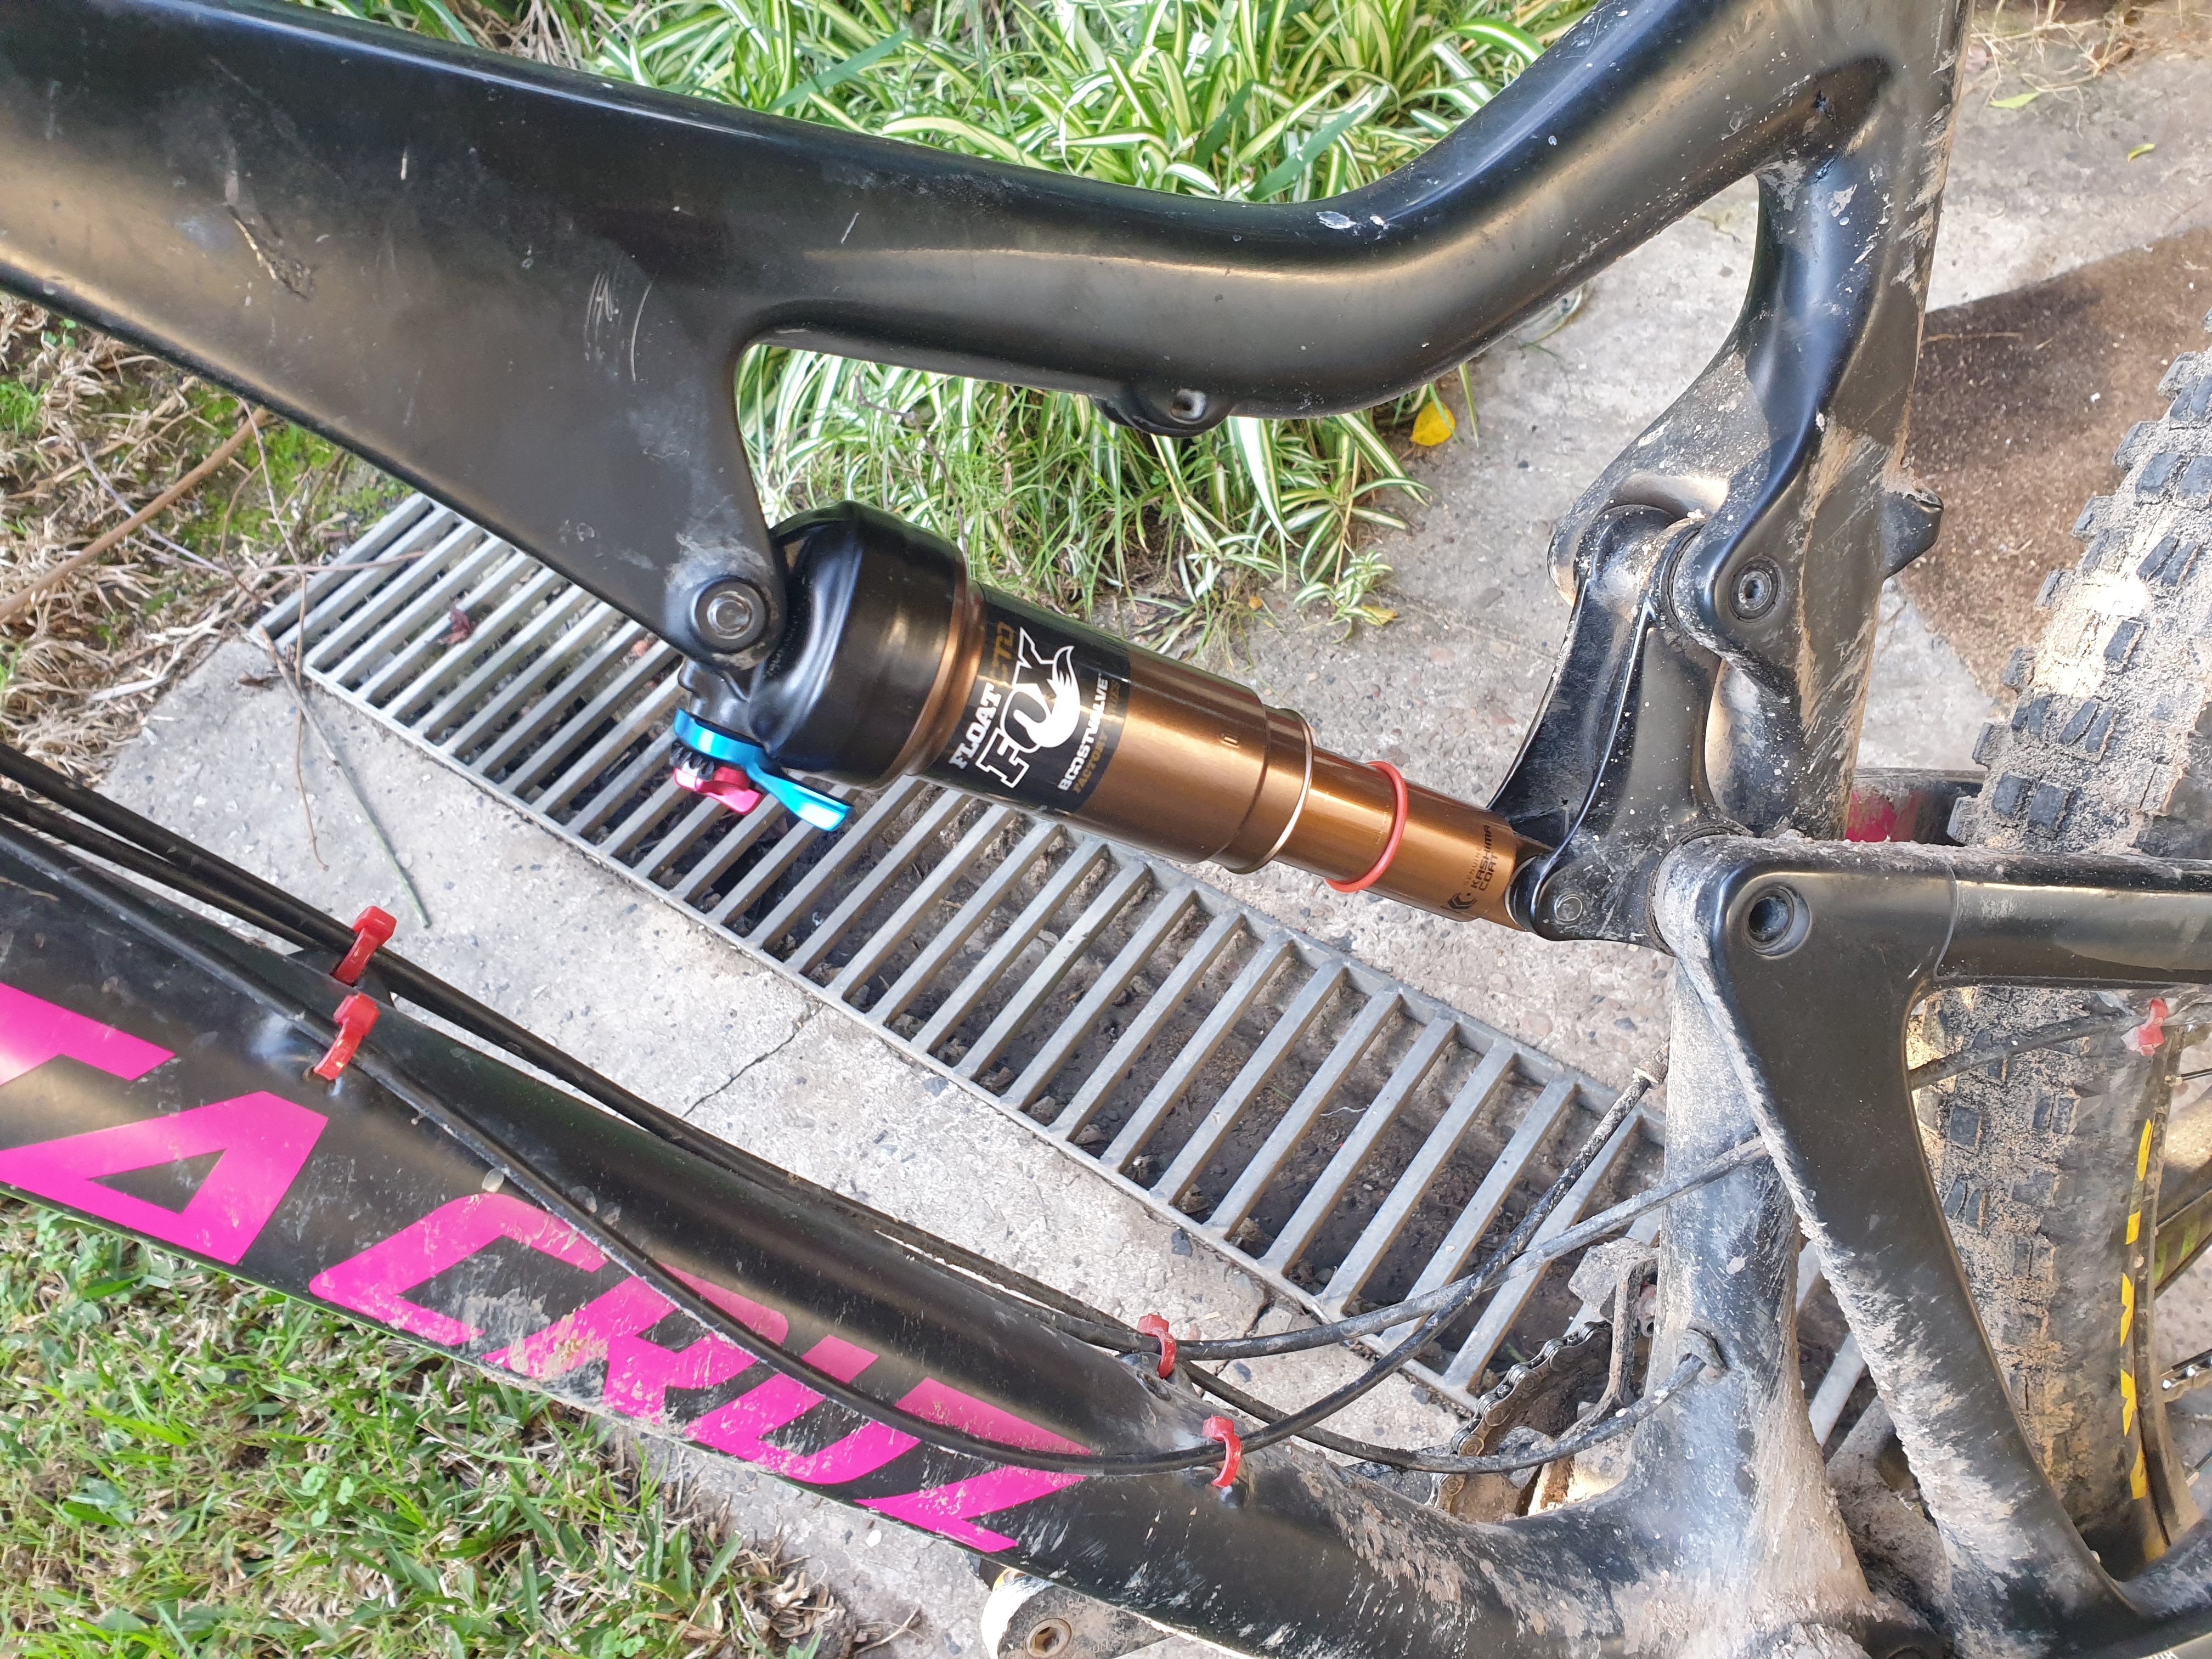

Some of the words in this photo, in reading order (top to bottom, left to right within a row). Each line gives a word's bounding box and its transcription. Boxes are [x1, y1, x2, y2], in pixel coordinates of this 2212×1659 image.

[949, 681, 1002, 769] FLOAT
[975, 626, 1081, 788] FOX
[1057, 678, 1109, 792] BOOSTVALVE
[1072, 729, 1108, 794] FACTORY
[1470, 824, 1493, 890] KASHIMA
[1478, 851, 1498, 891] COAT
[308, 1193, 1092, 1553] CRUZ
